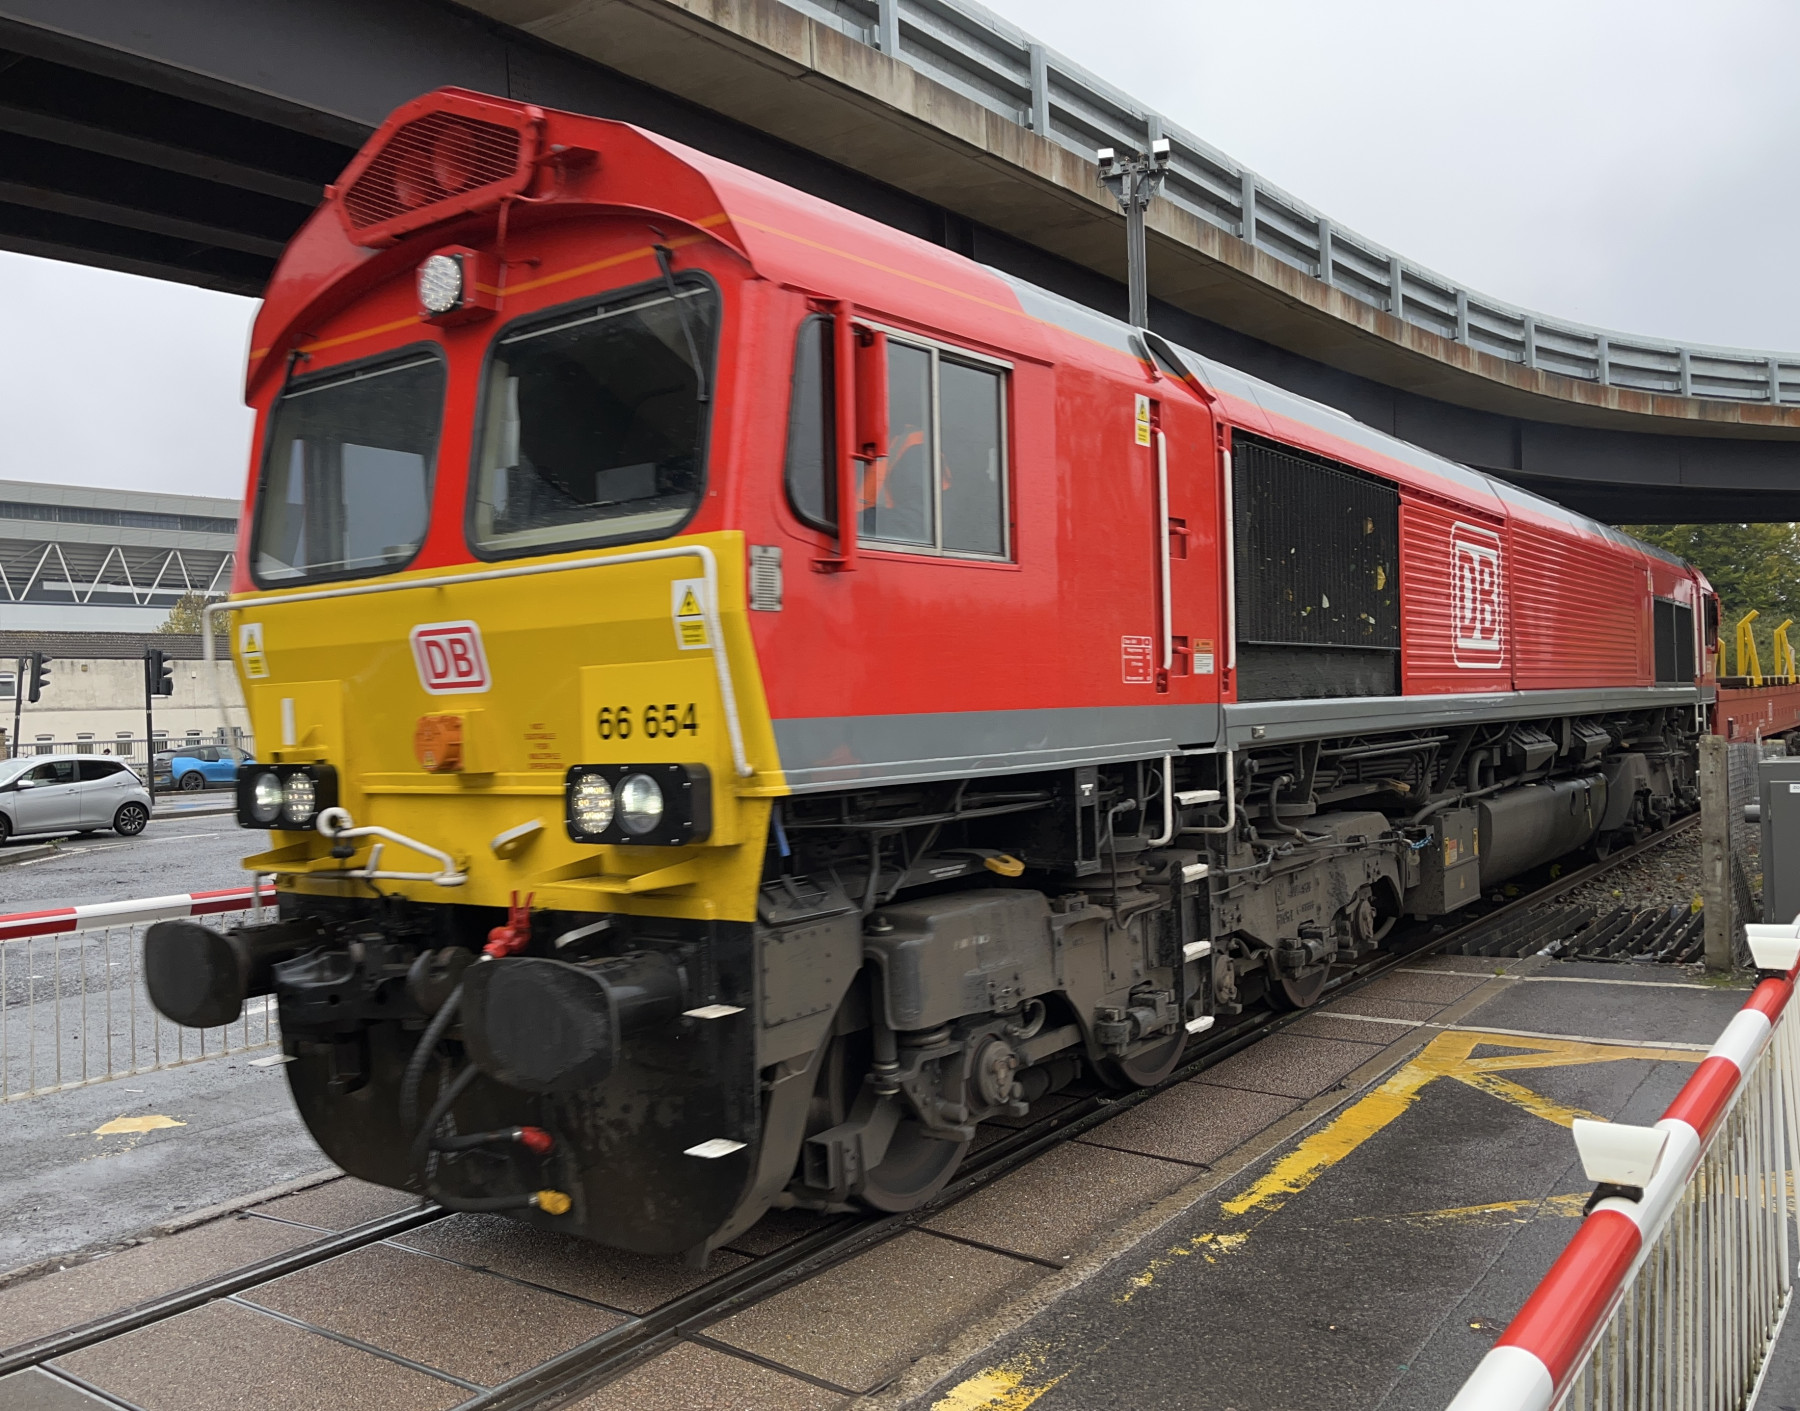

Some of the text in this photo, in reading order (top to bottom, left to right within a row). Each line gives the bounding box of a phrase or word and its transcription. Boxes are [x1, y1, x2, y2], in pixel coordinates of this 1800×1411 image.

[1457, 549, 1498, 641] DB
[424, 637, 475, 680] DB
[597, 702, 699, 740] 66 654
